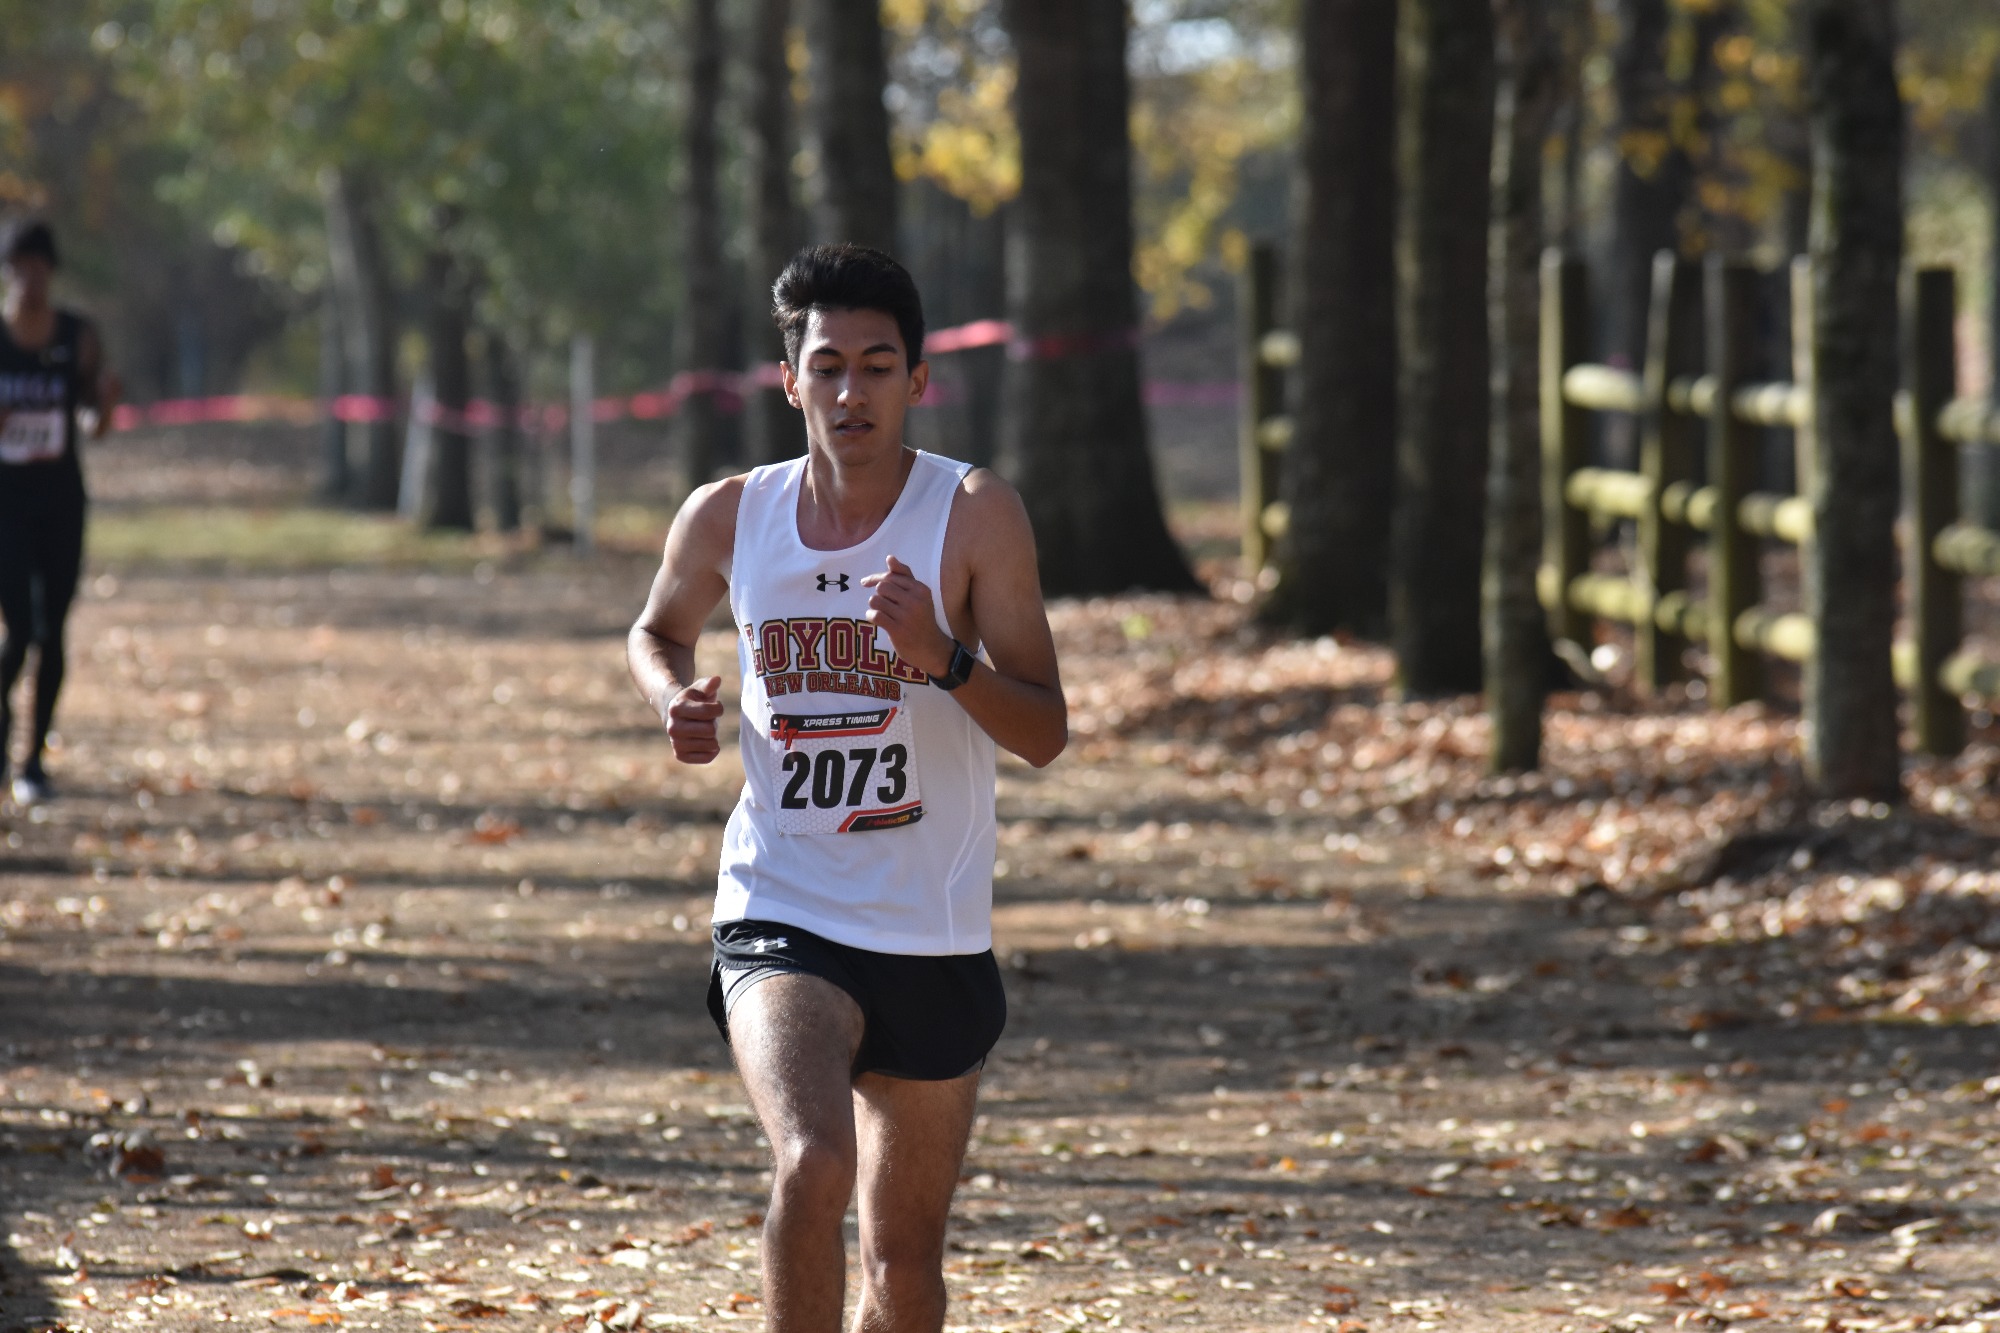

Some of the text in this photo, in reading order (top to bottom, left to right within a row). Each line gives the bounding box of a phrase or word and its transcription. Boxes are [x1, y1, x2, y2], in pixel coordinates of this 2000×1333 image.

[764, 672, 901, 701] NEW ORLEANS
[774, 718, 798, 750] XT
[802, 714, 880, 728] XPRESS TIMING
[781, 743, 908, 810] 2073
